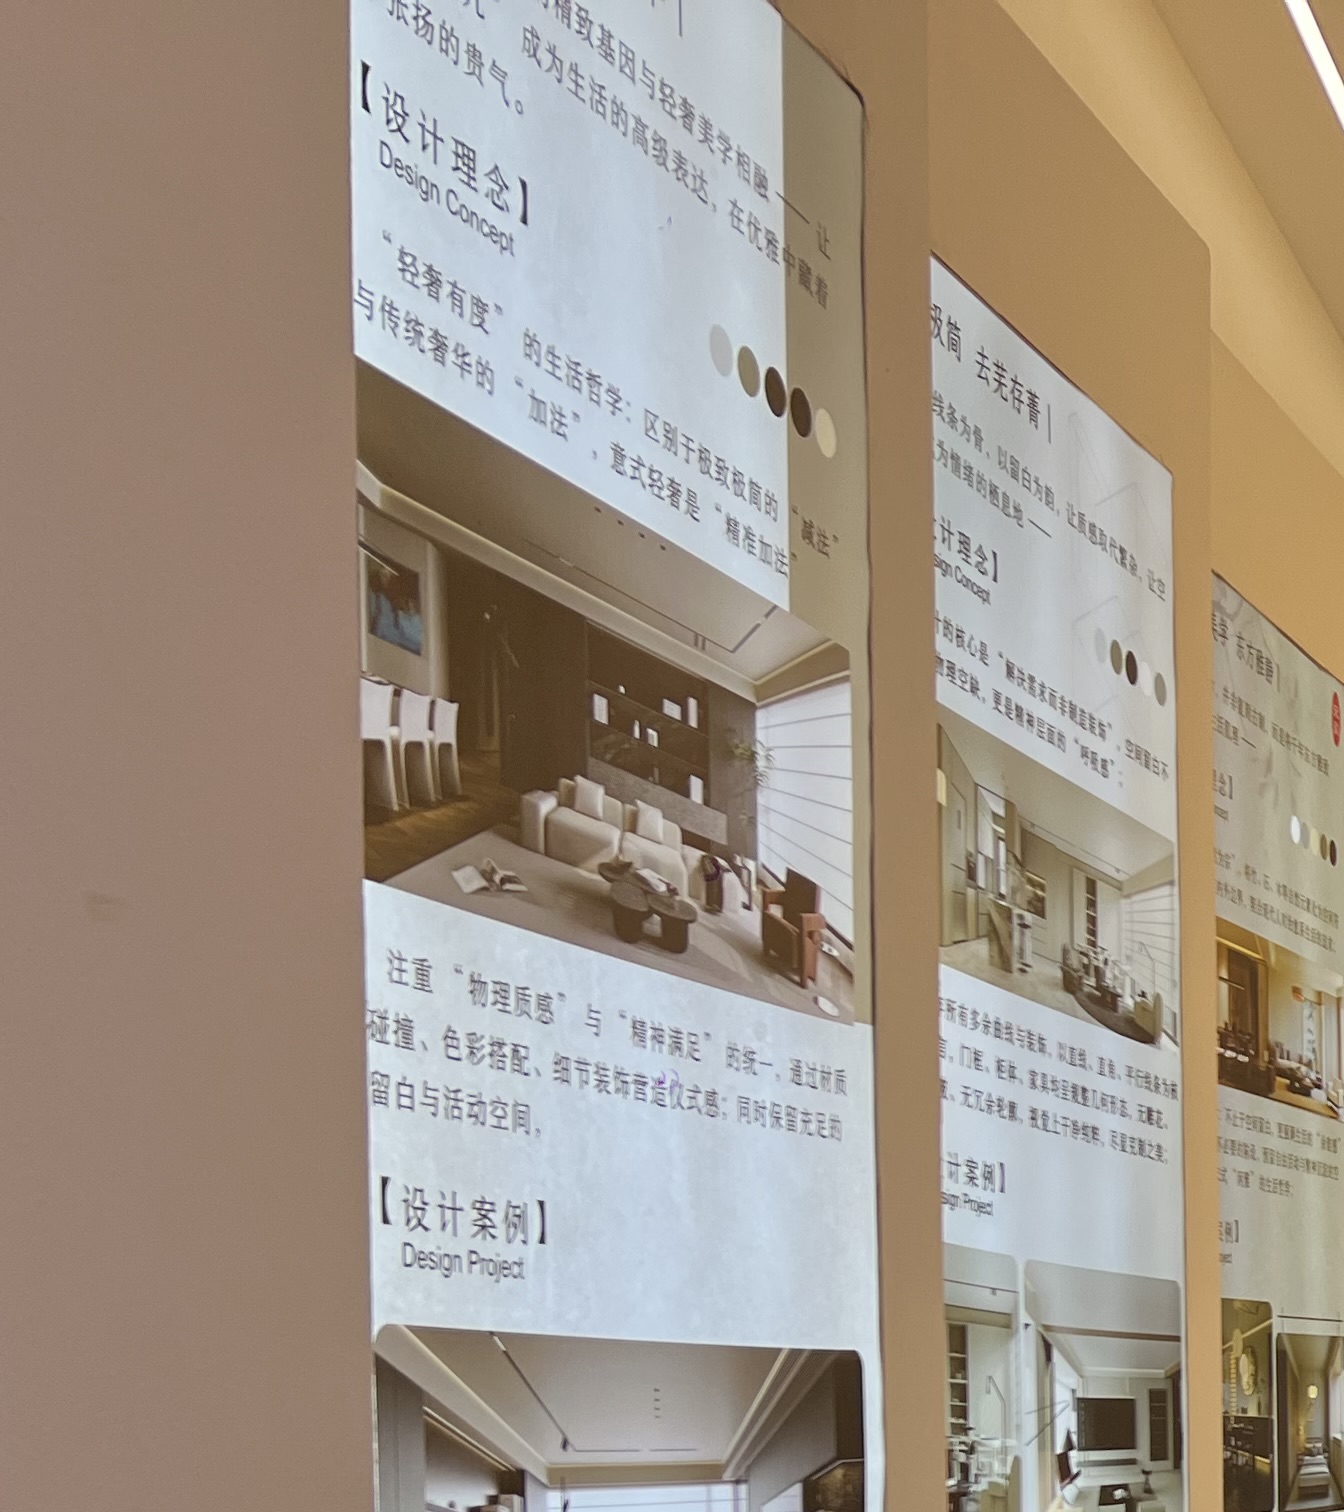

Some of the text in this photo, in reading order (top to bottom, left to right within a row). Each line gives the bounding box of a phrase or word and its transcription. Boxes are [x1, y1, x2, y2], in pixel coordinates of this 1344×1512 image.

[379, 139, 516, 258] Design Concept
[934, 520, 1000, 584] 计理念】
[954, 567, 991, 605] Concept
[402, 1241, 526, 1284] Design Project
